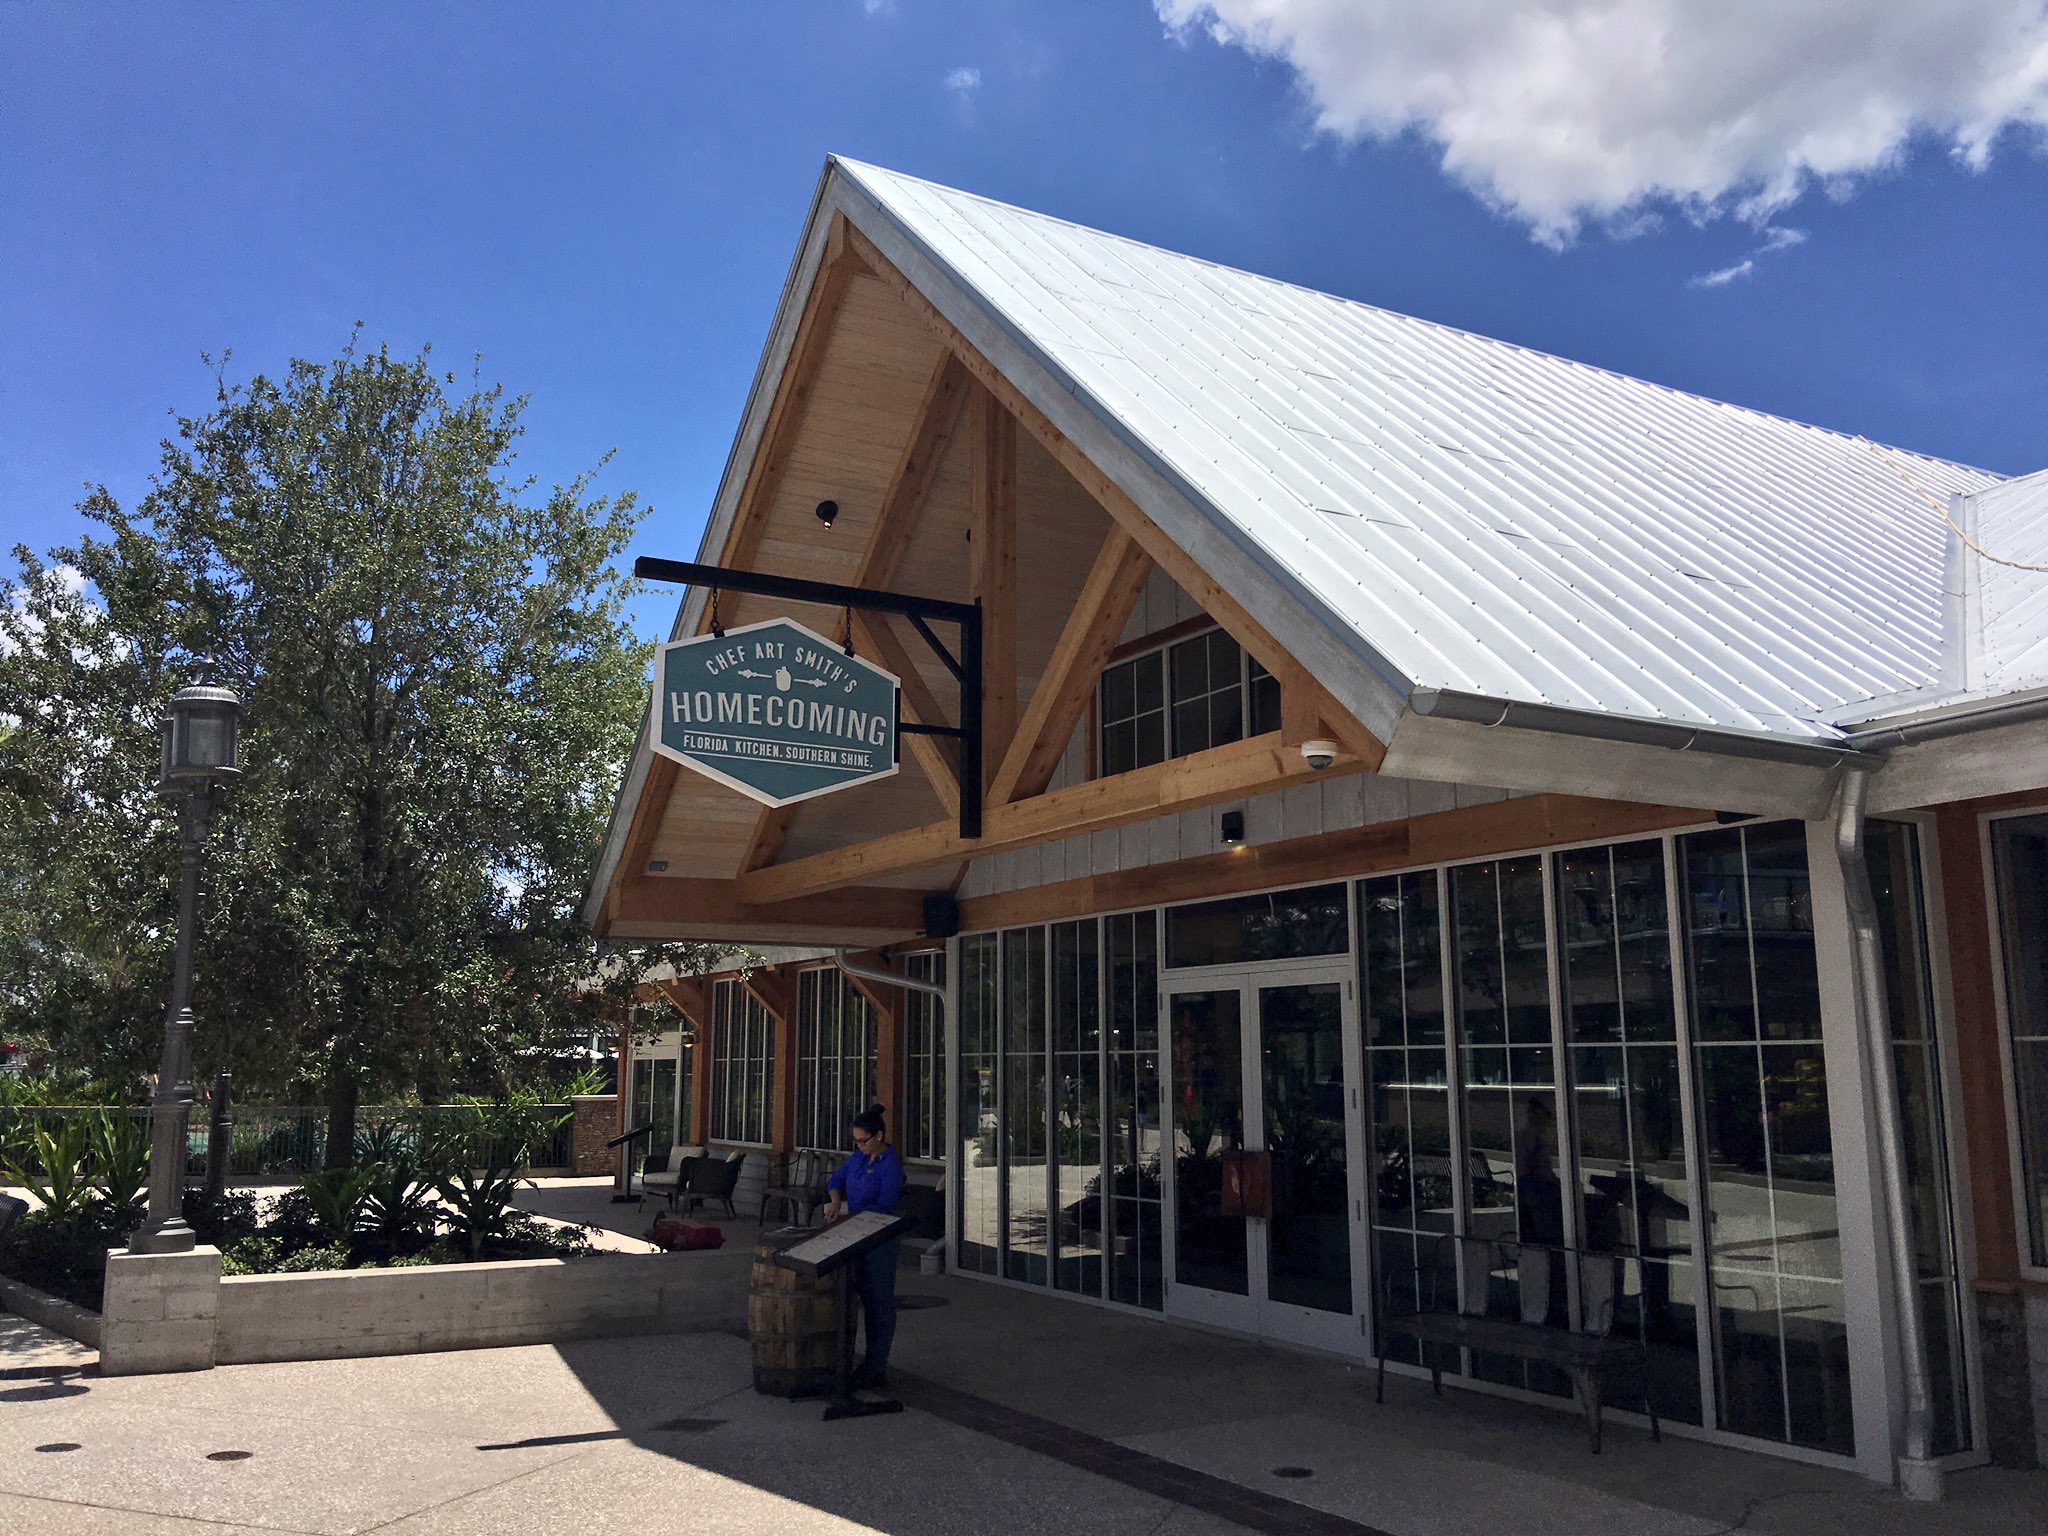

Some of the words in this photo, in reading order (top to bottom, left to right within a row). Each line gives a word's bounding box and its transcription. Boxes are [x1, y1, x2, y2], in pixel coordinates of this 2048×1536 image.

[705, 645, 747, 676] CHEF
[755, 642, 785, 660] ART
[795, 647, 858, 694] SMITH'S
[670, 691, 888, 747] HOMECOMING
[683, 735, 729, 752] FLORIDA
[735, 740, 783, 758] KITCHEN.
[785, 746, 837, 764] SOUTHERN
[840, 752, 874, 768] SHINE.
